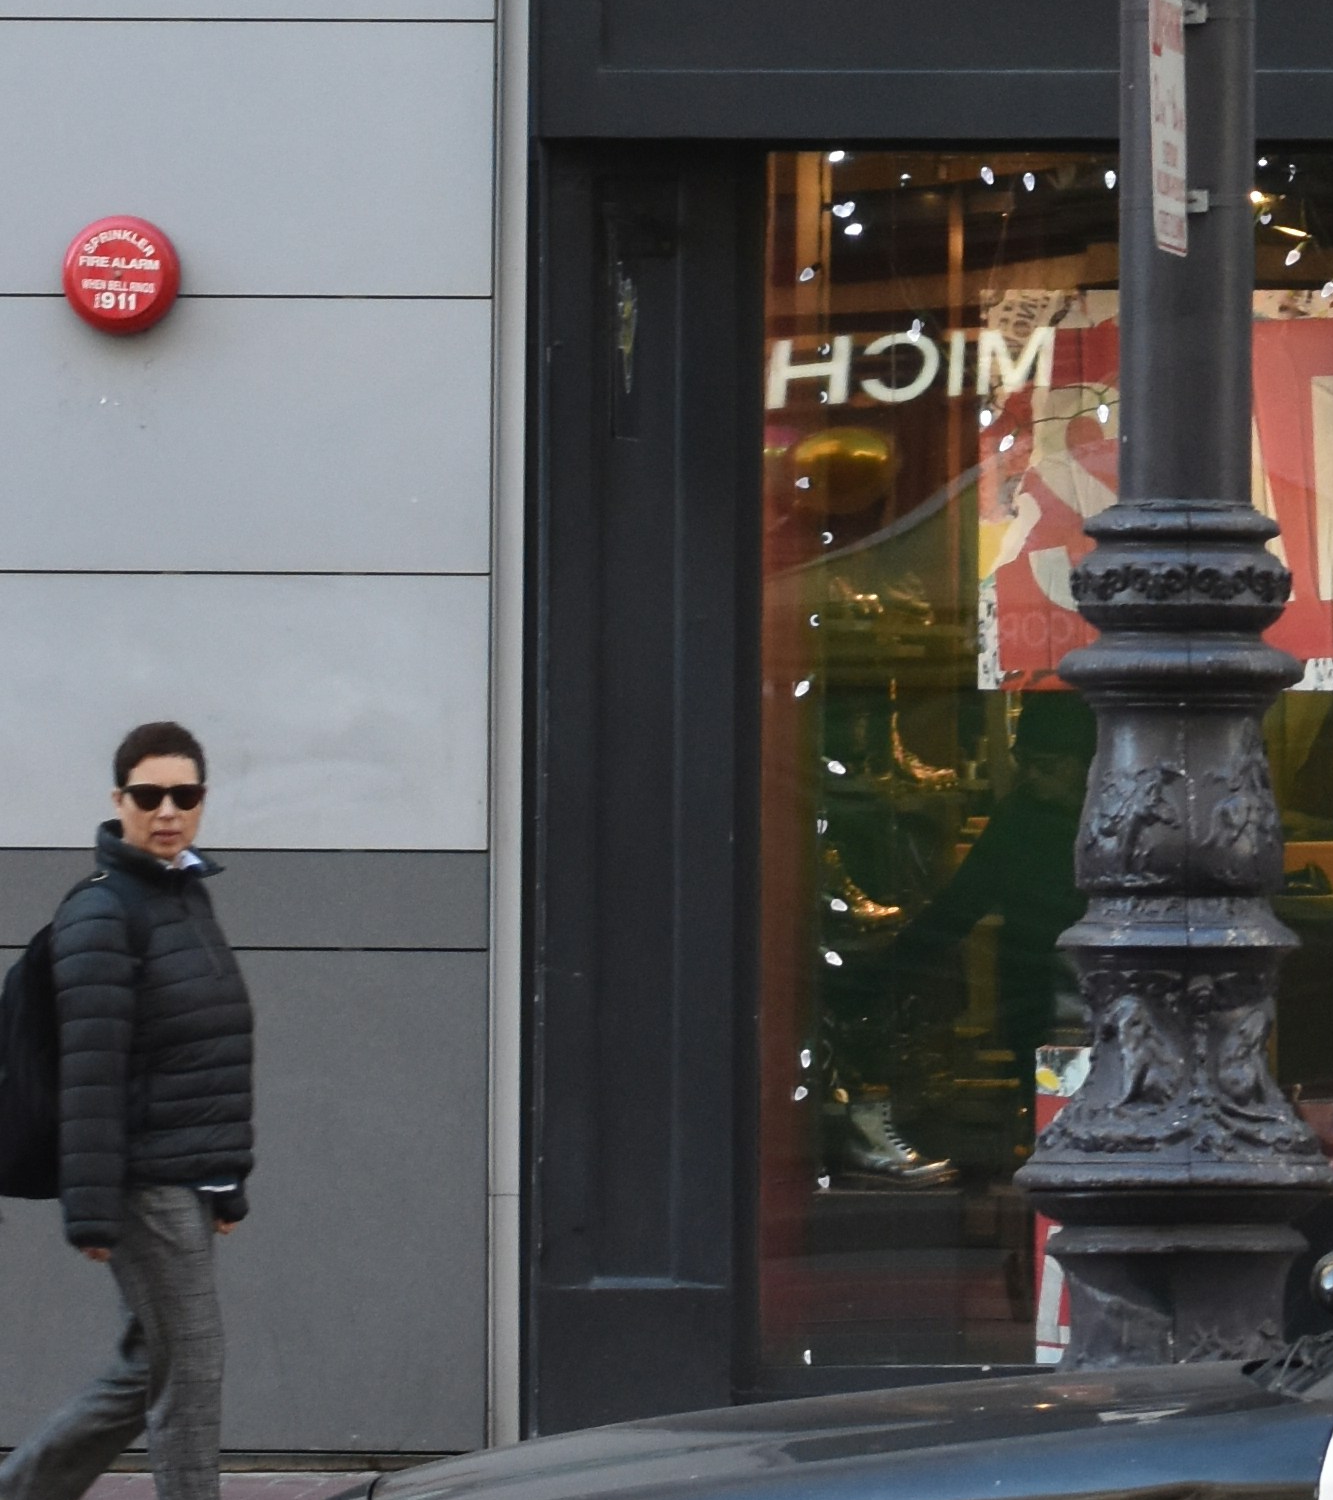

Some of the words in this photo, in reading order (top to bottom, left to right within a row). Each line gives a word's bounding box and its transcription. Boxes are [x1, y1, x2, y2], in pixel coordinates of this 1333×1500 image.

[83, 229, 155, 257] SPRINKLER
[79, 256, 110, 268] FIRE
[112, 257, 160, 270] ALARM
[82, 279, 106, 290] WHEN
[108, 280, 129, 291] BELL
[130, 282, 155, 293] RINGS
[101, 292, 137, 310] 911
